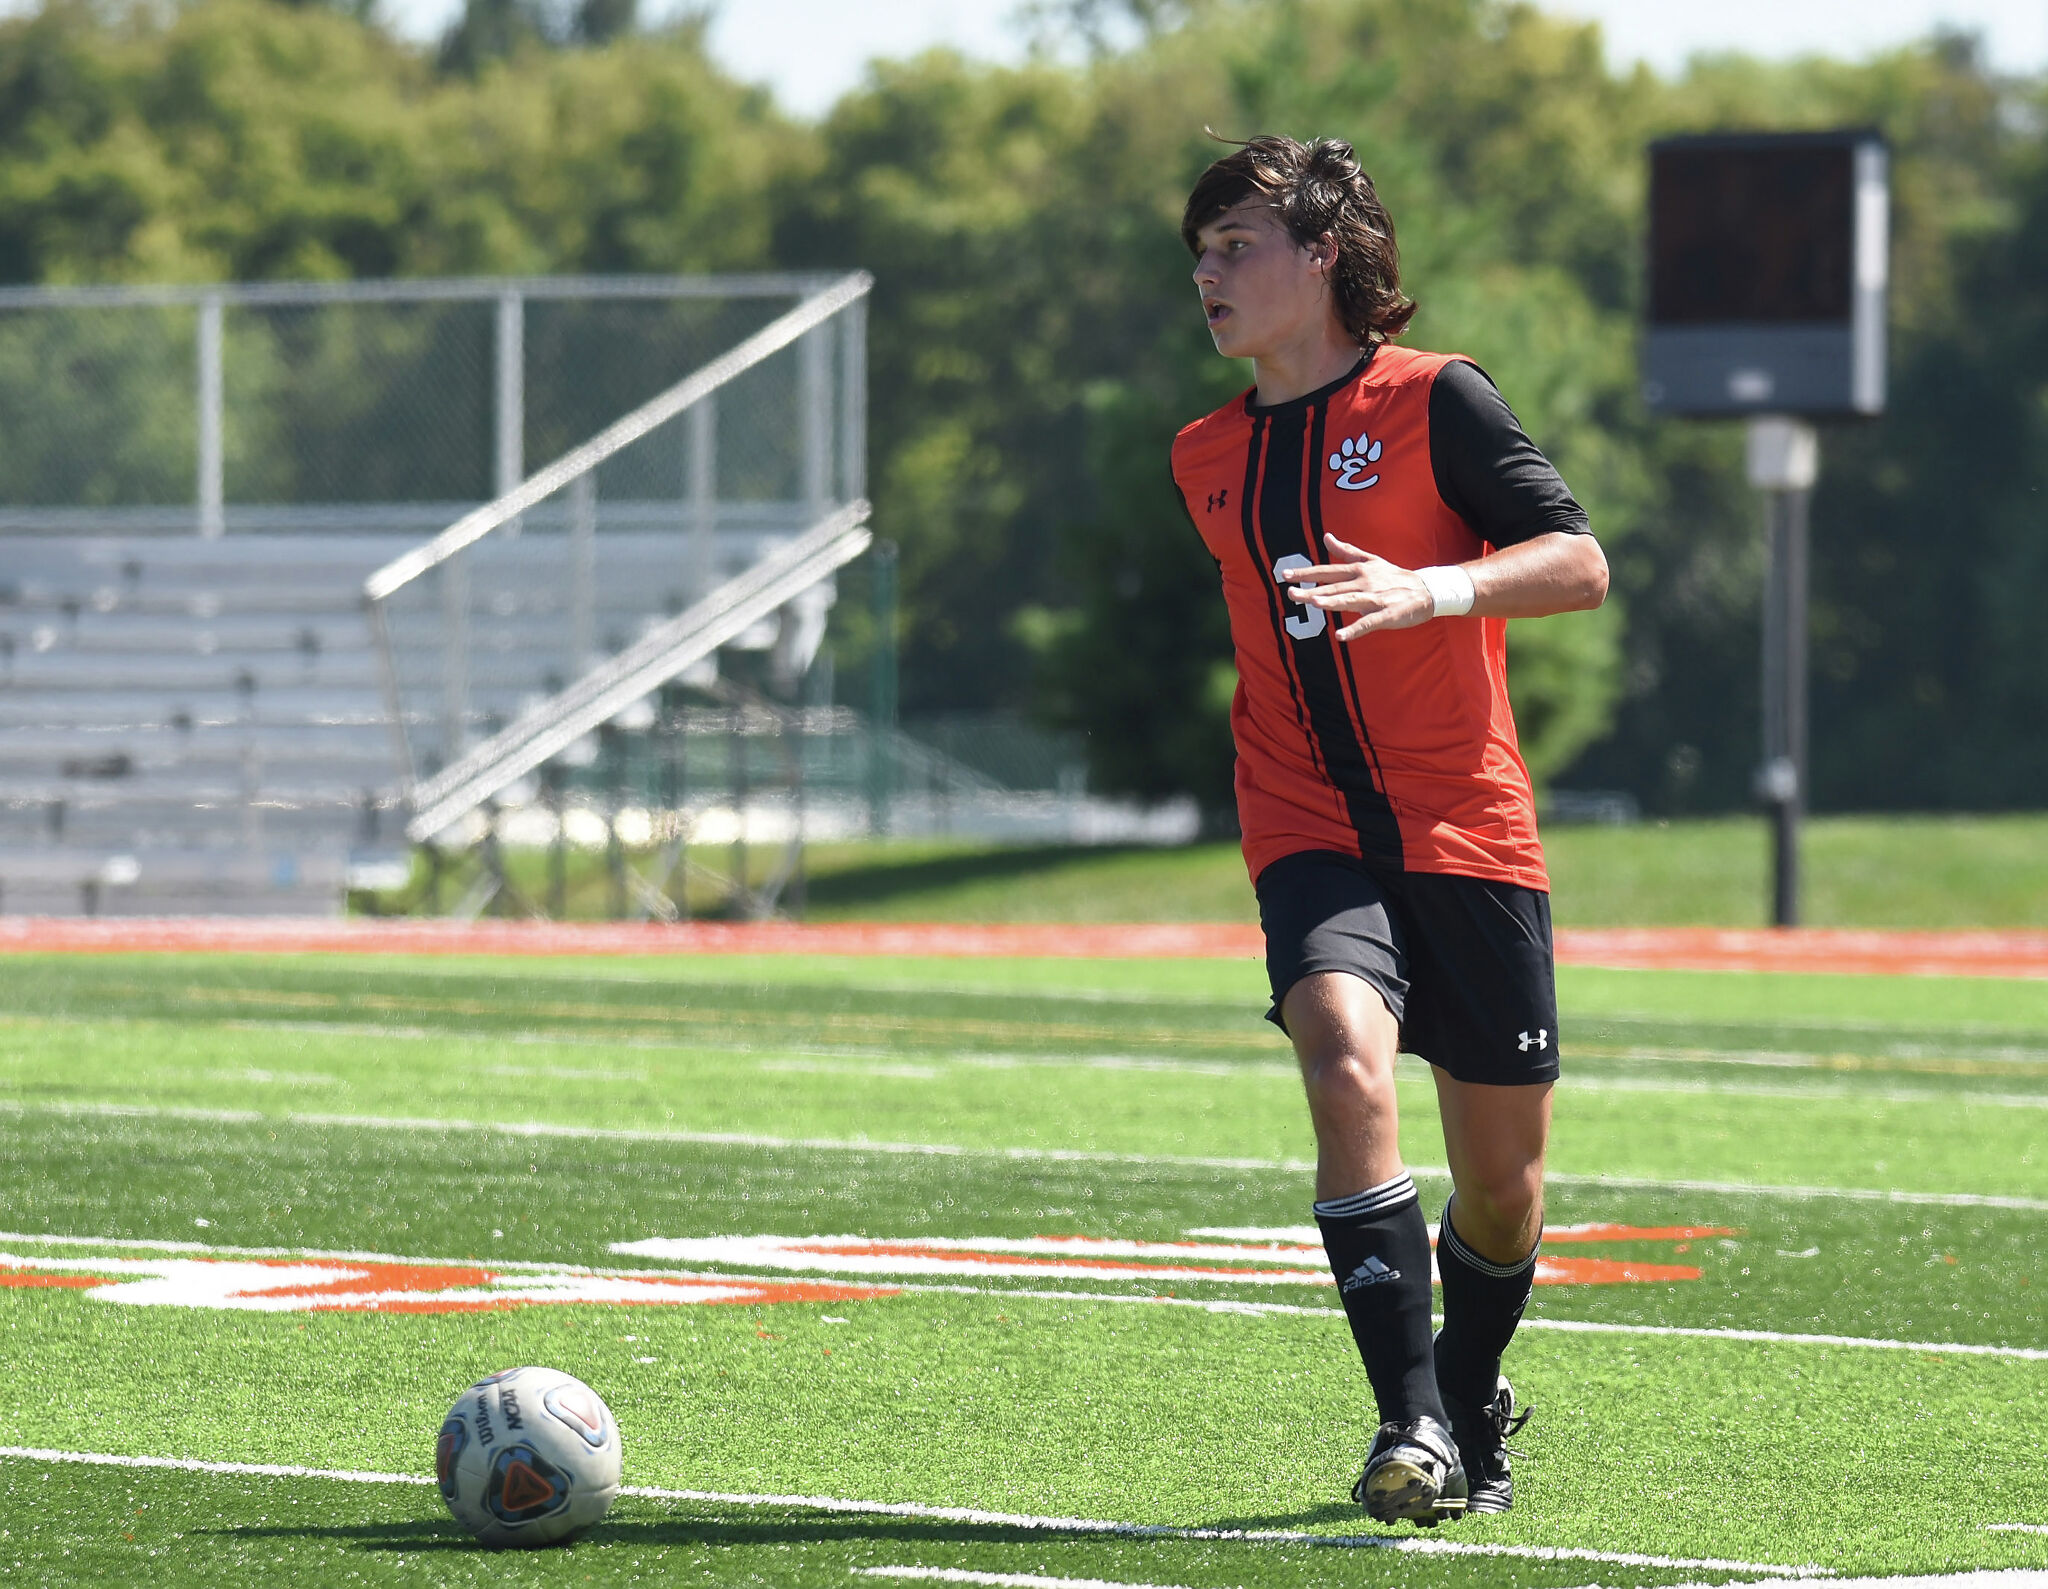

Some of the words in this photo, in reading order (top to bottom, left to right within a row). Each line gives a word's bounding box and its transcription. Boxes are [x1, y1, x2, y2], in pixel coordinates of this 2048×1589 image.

[1343, 1270, 1401, 1293] adidas
[475, 1393, 494, 1447] Wilson
[502, 1389, 523, 1430] NCAA
